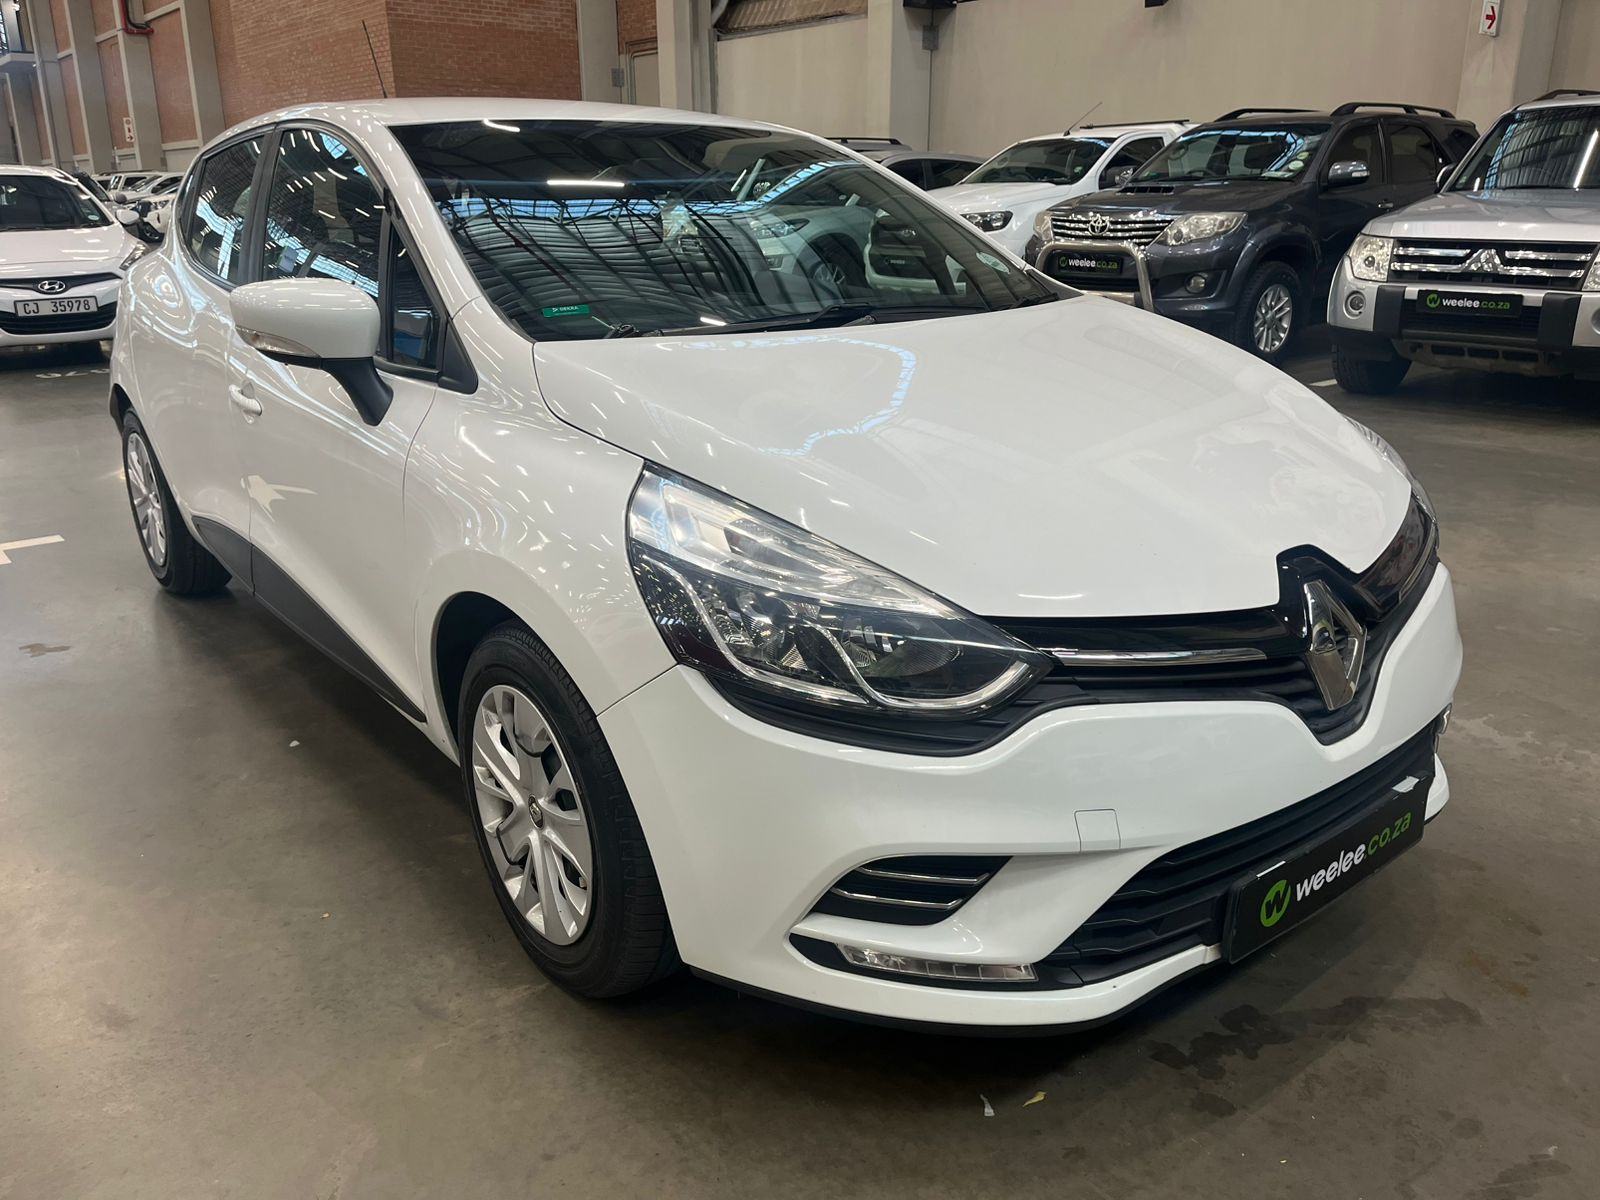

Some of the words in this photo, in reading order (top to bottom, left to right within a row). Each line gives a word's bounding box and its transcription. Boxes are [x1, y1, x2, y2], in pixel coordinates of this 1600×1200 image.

[1068, 257, 1118, 269] weelee.co.za
[23, 302, 40, 315] CJ
[51, 299, 91, 313] 35978
[1442, 297, 1510, 309] weelee.co.za
[1296, 812, 1412, 902] weelee.co.za
